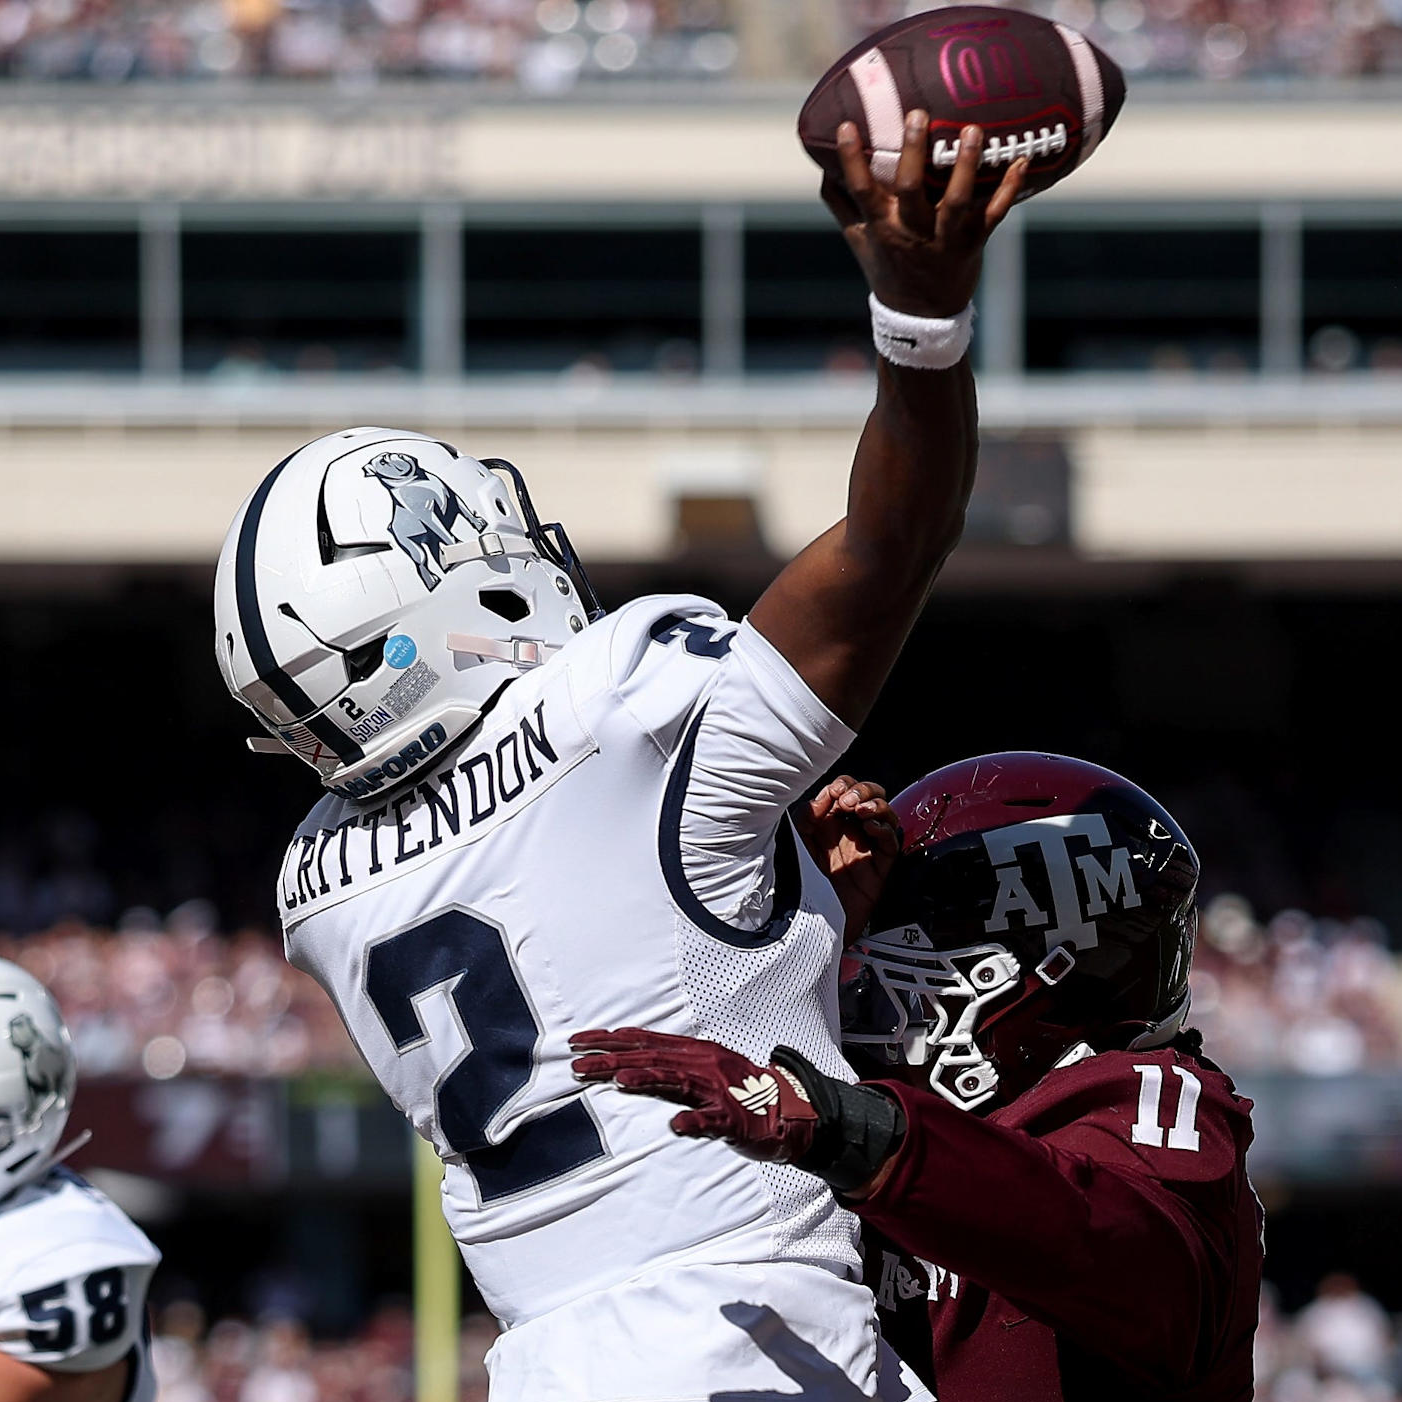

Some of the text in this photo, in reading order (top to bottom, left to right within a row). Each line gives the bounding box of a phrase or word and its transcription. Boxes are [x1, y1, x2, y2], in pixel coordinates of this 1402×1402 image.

[338, 697, 366, 721] 2
[282, 699, 560, 910] CRITTENDON
[360, 901, 615, 1210] 2
[1131, 1064, 1202, 1152] 11
[20, 1265, 128, 1353] 58
